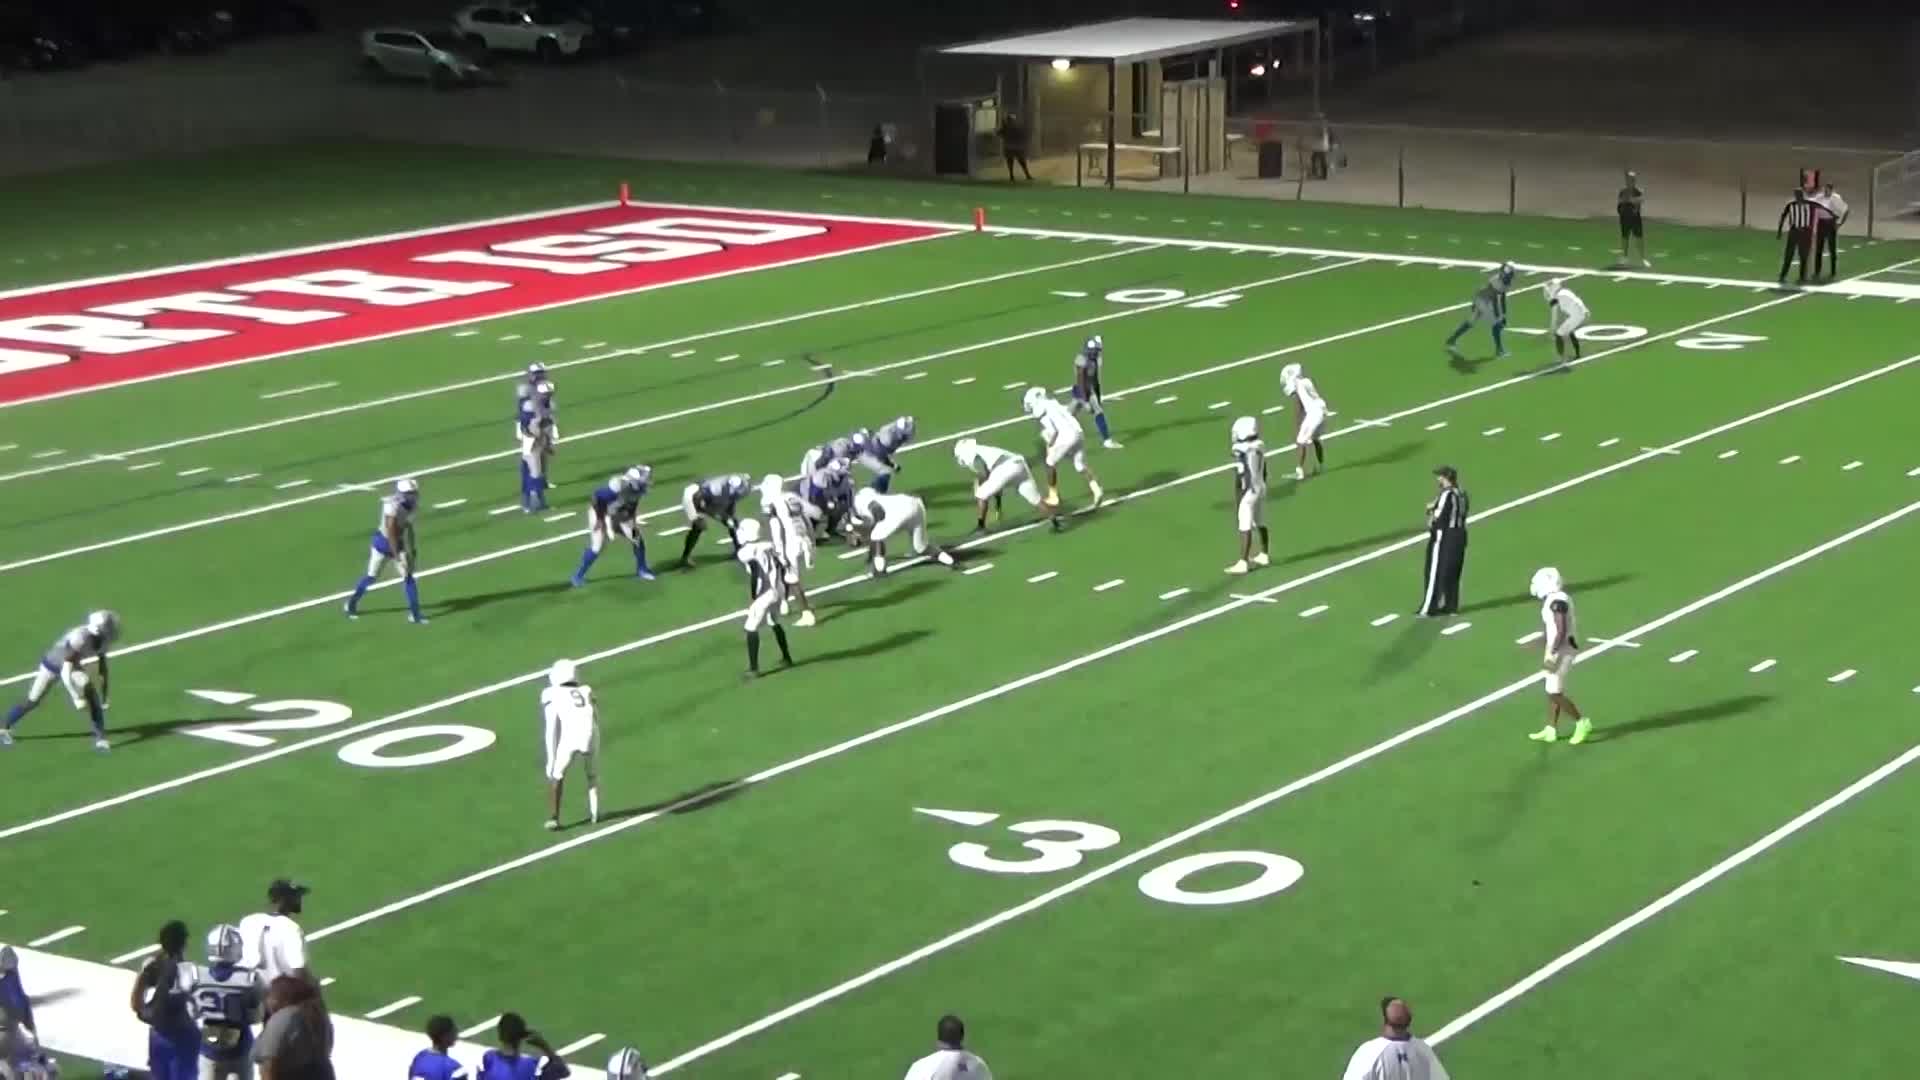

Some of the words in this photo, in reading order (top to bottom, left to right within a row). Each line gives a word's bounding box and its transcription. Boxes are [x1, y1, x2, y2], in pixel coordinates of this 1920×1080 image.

[409, 217, 829, 275] ISD
[1573, 324, 1768, 350] 20
[179, 699, 497, 768] 20
[948, 819, 1305, 905] 30
